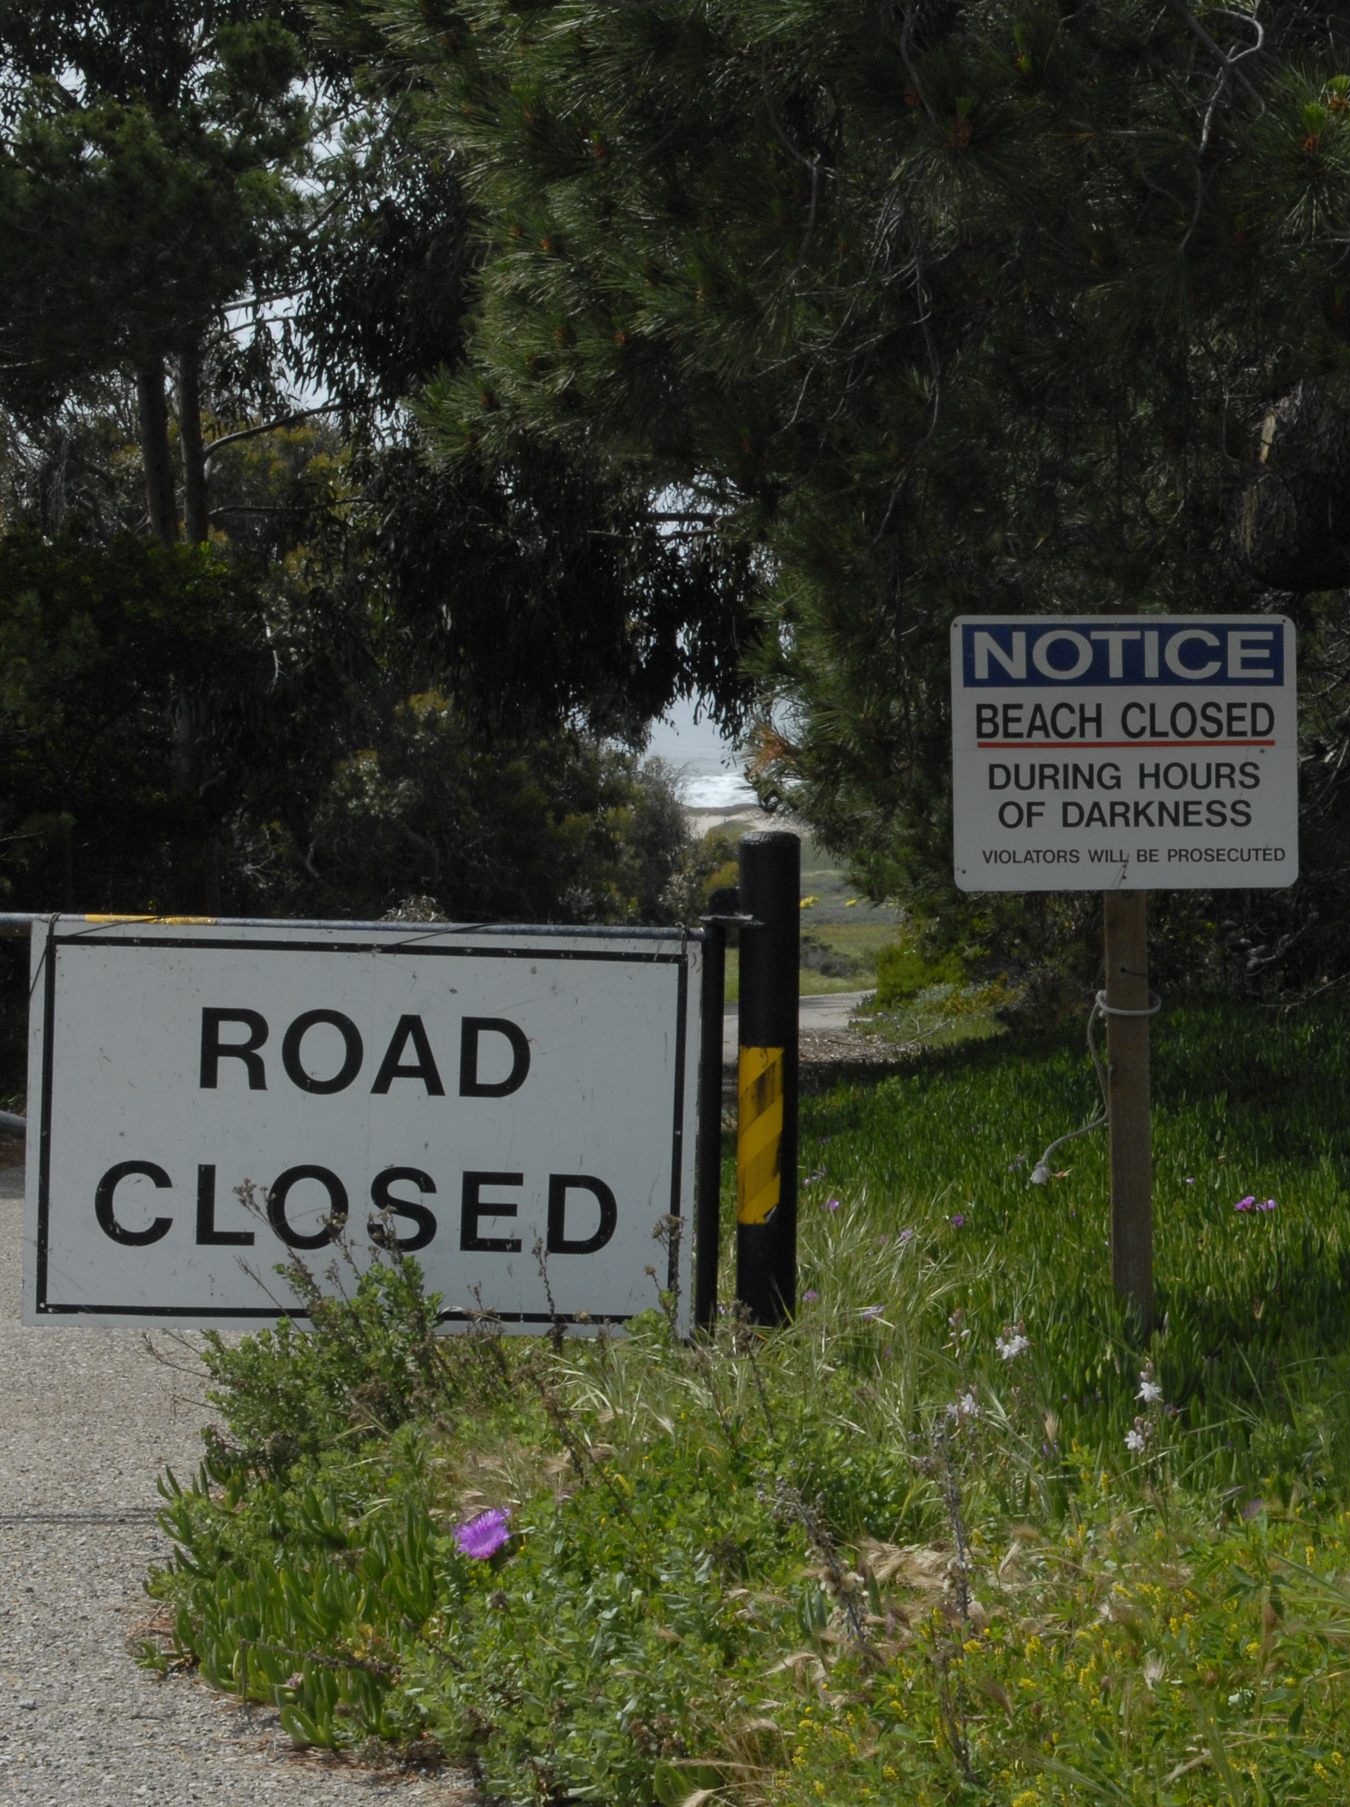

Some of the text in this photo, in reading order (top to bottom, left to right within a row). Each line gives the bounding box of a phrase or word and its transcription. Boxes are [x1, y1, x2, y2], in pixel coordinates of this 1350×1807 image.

[974, 630, 1274, 679] NOTICE
[976, 702, 1274, 739] BEACH CLOSED
[989, 762, 1260, 790] DURING HOURS
[999, 800, 1251, 828] OF DARKNESS
[982, 848, 1285, 864] VIOLATORS WILL BE PROSECUTED
[200, 1007, 530, 1098] ROAD
[95, 1160, 618, 1255] CLOSED
